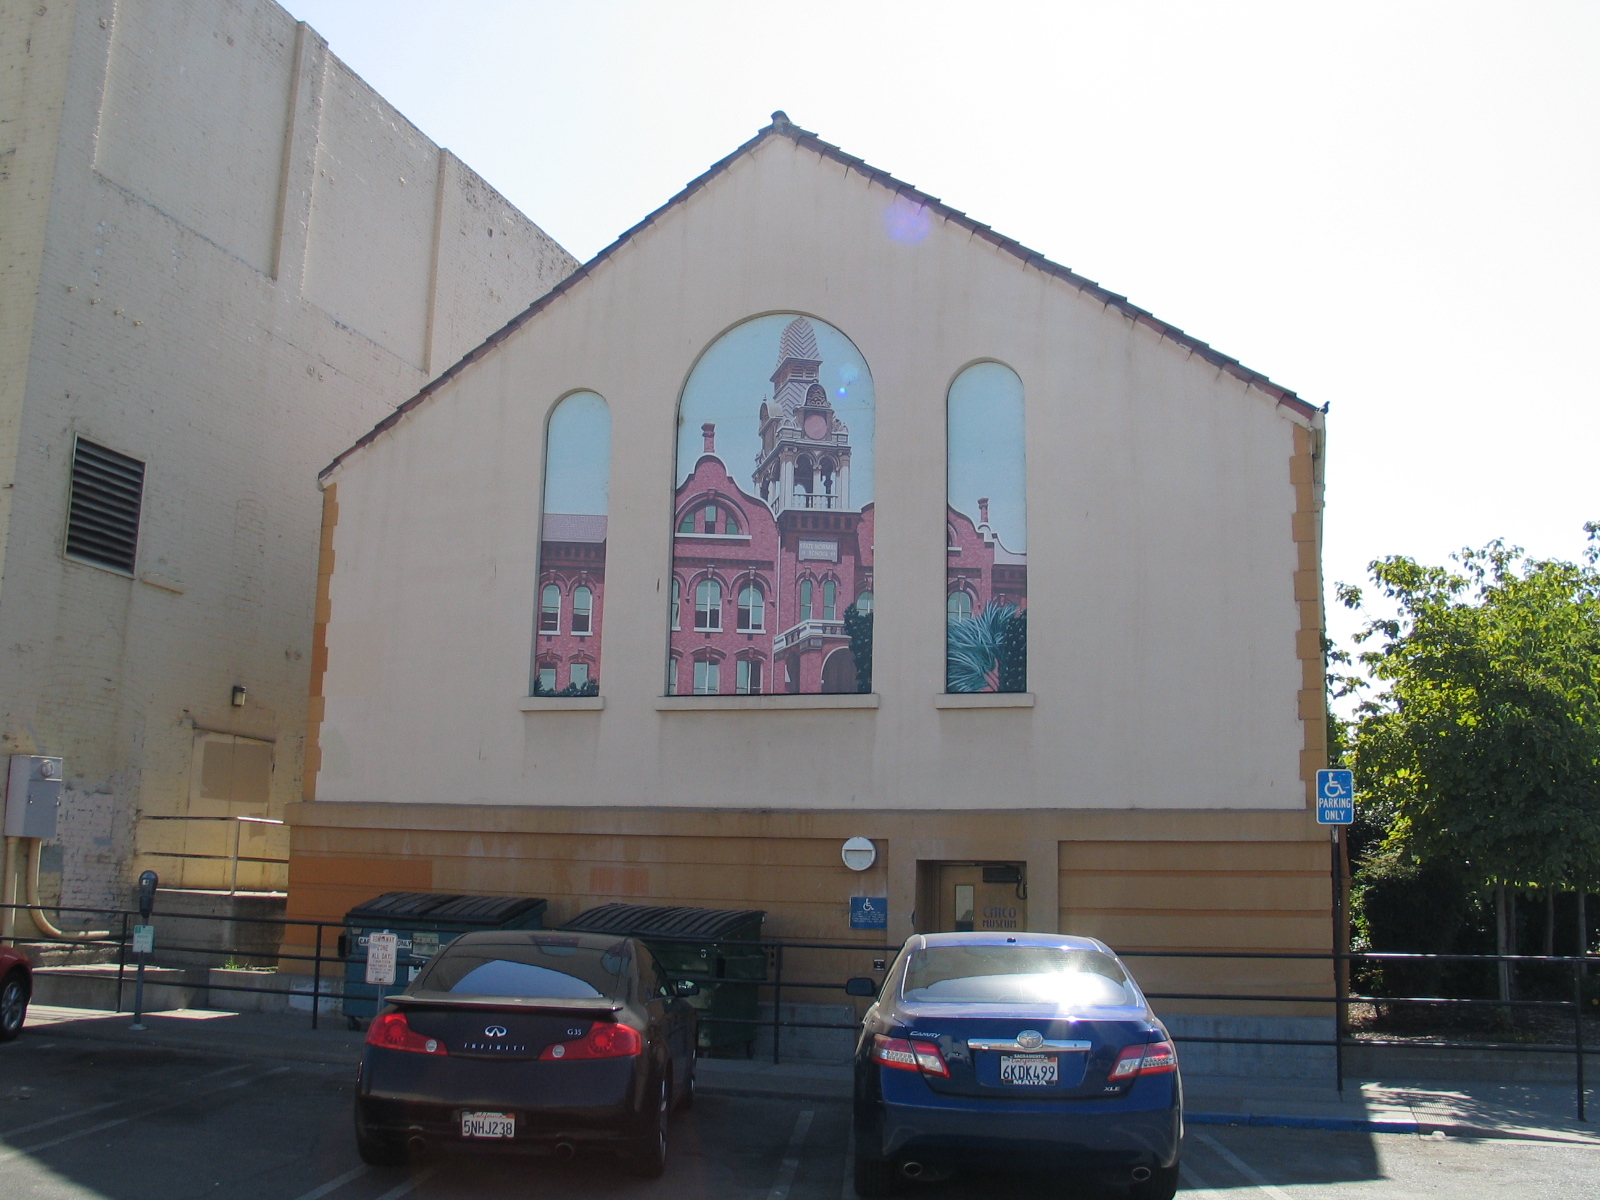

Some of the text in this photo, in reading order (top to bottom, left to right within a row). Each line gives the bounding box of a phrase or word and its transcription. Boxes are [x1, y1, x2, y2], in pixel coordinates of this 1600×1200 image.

[1319, 797, 1351, 808] PARKING
[1324, 810, 1346, 821] ONLY
[982, 905, 1017, 919] CHICO
[982, 919, 1017, 928] MUSEUM
[377, 944, 389, 952] ZONE
[567, 1028, 582, 1036] G35
[1003, 1065, 1055, 1080] 6KDK499
[472, 1112, 503, 1121] California
[463, 1120, 513, 1136] 5NHJ238
